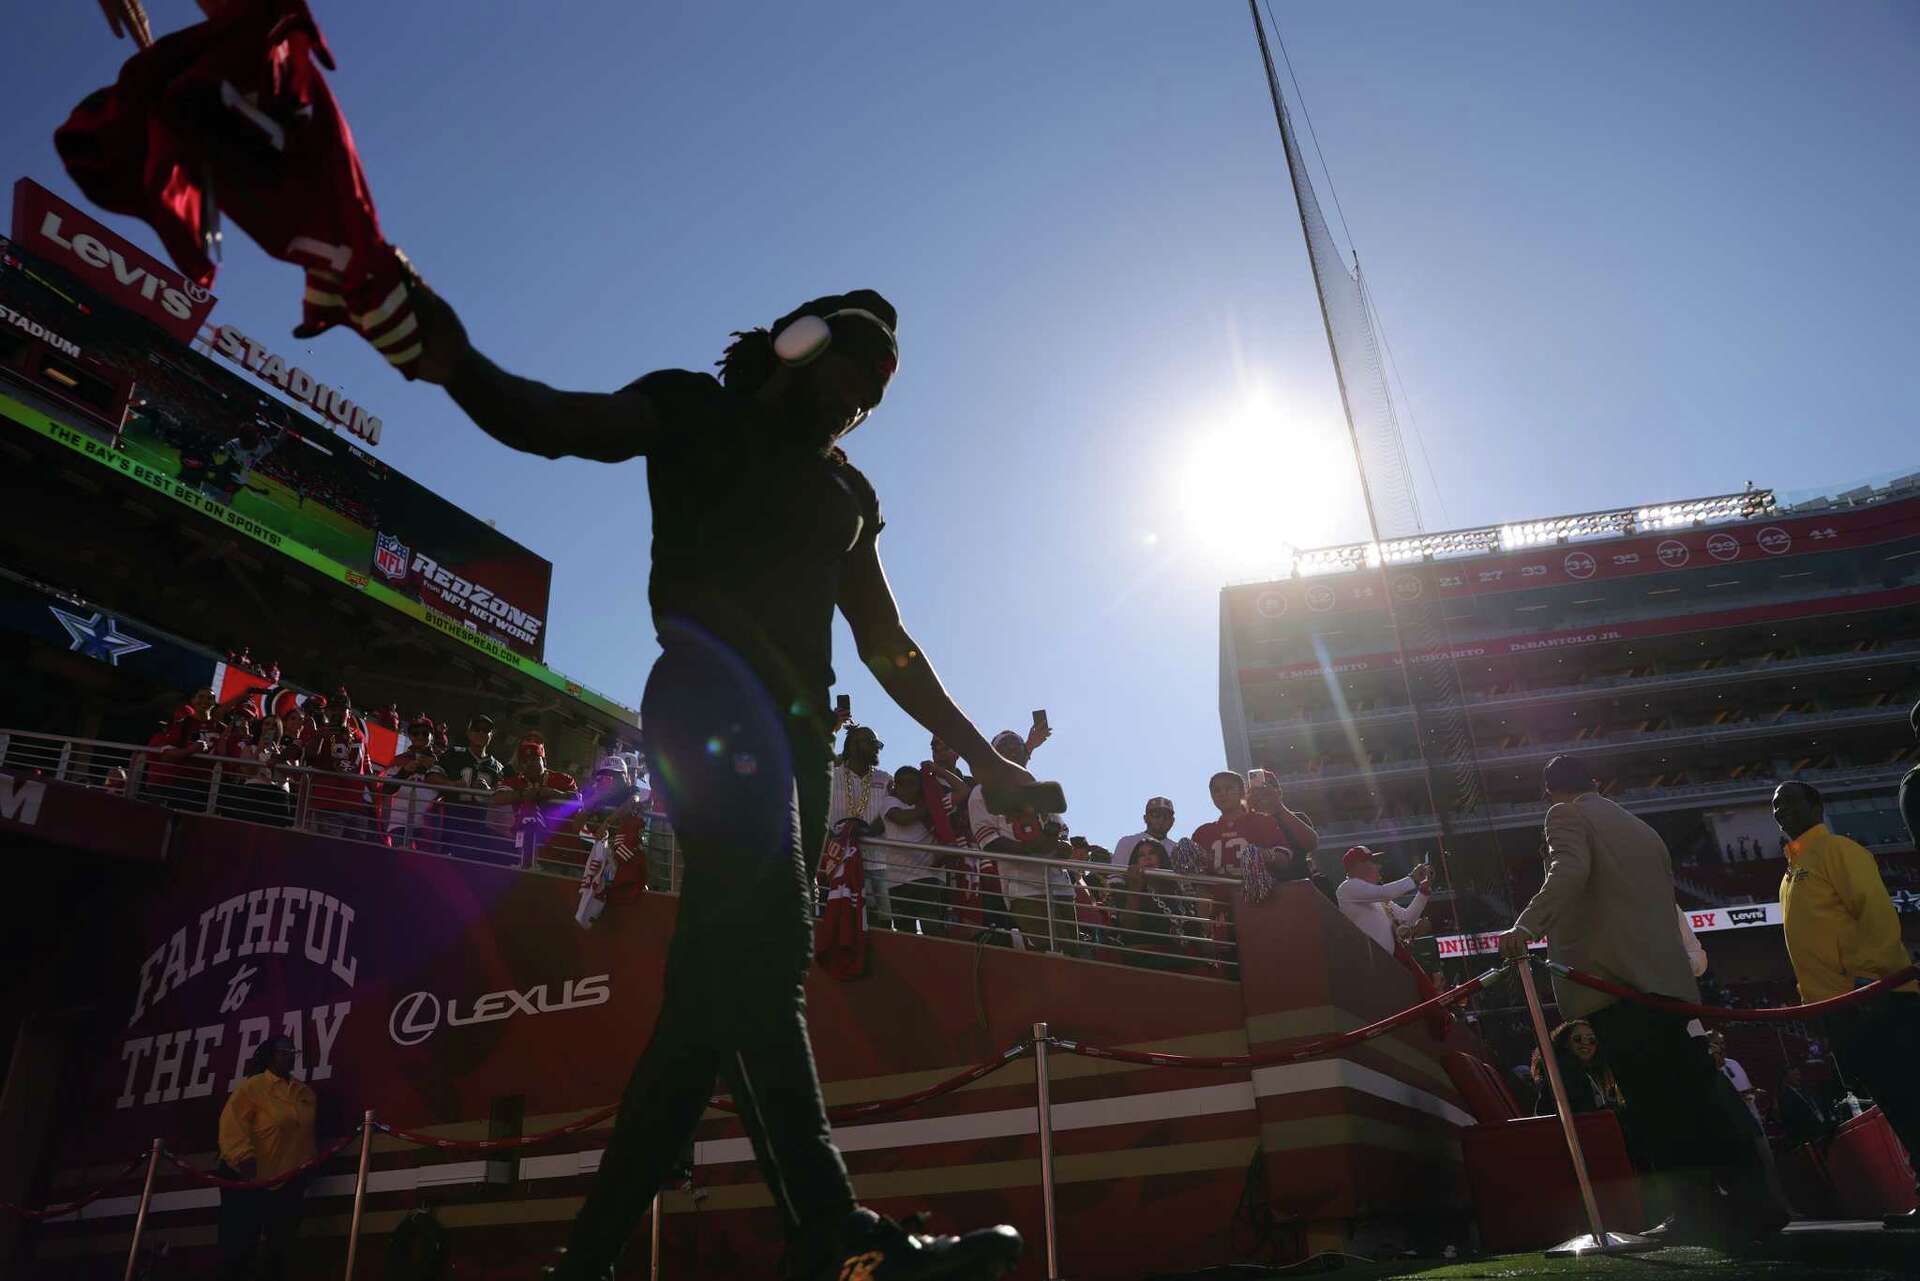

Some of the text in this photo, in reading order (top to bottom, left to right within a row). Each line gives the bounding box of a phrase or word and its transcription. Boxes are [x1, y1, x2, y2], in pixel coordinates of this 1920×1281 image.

[0, 304, 81, 359] STADIUM
[213, 323, 384, 447] STADIUM
[49, 422, 282, 548] THE BAY'S BEST BET ON SPORTS!
[1440, 575, 1463, 588] 21
[440, 588, 467, 611] NFL
[469, 604, 537, 646] NETWORK
[1690, 913, 1716, 929] BY
[129, 886, 359, 1029] FAITHFUL
[219, 966, 259, 1014] to
[446, 974, 611, 1027] LEXUS
[116, 1024, 224, 1110] THE
